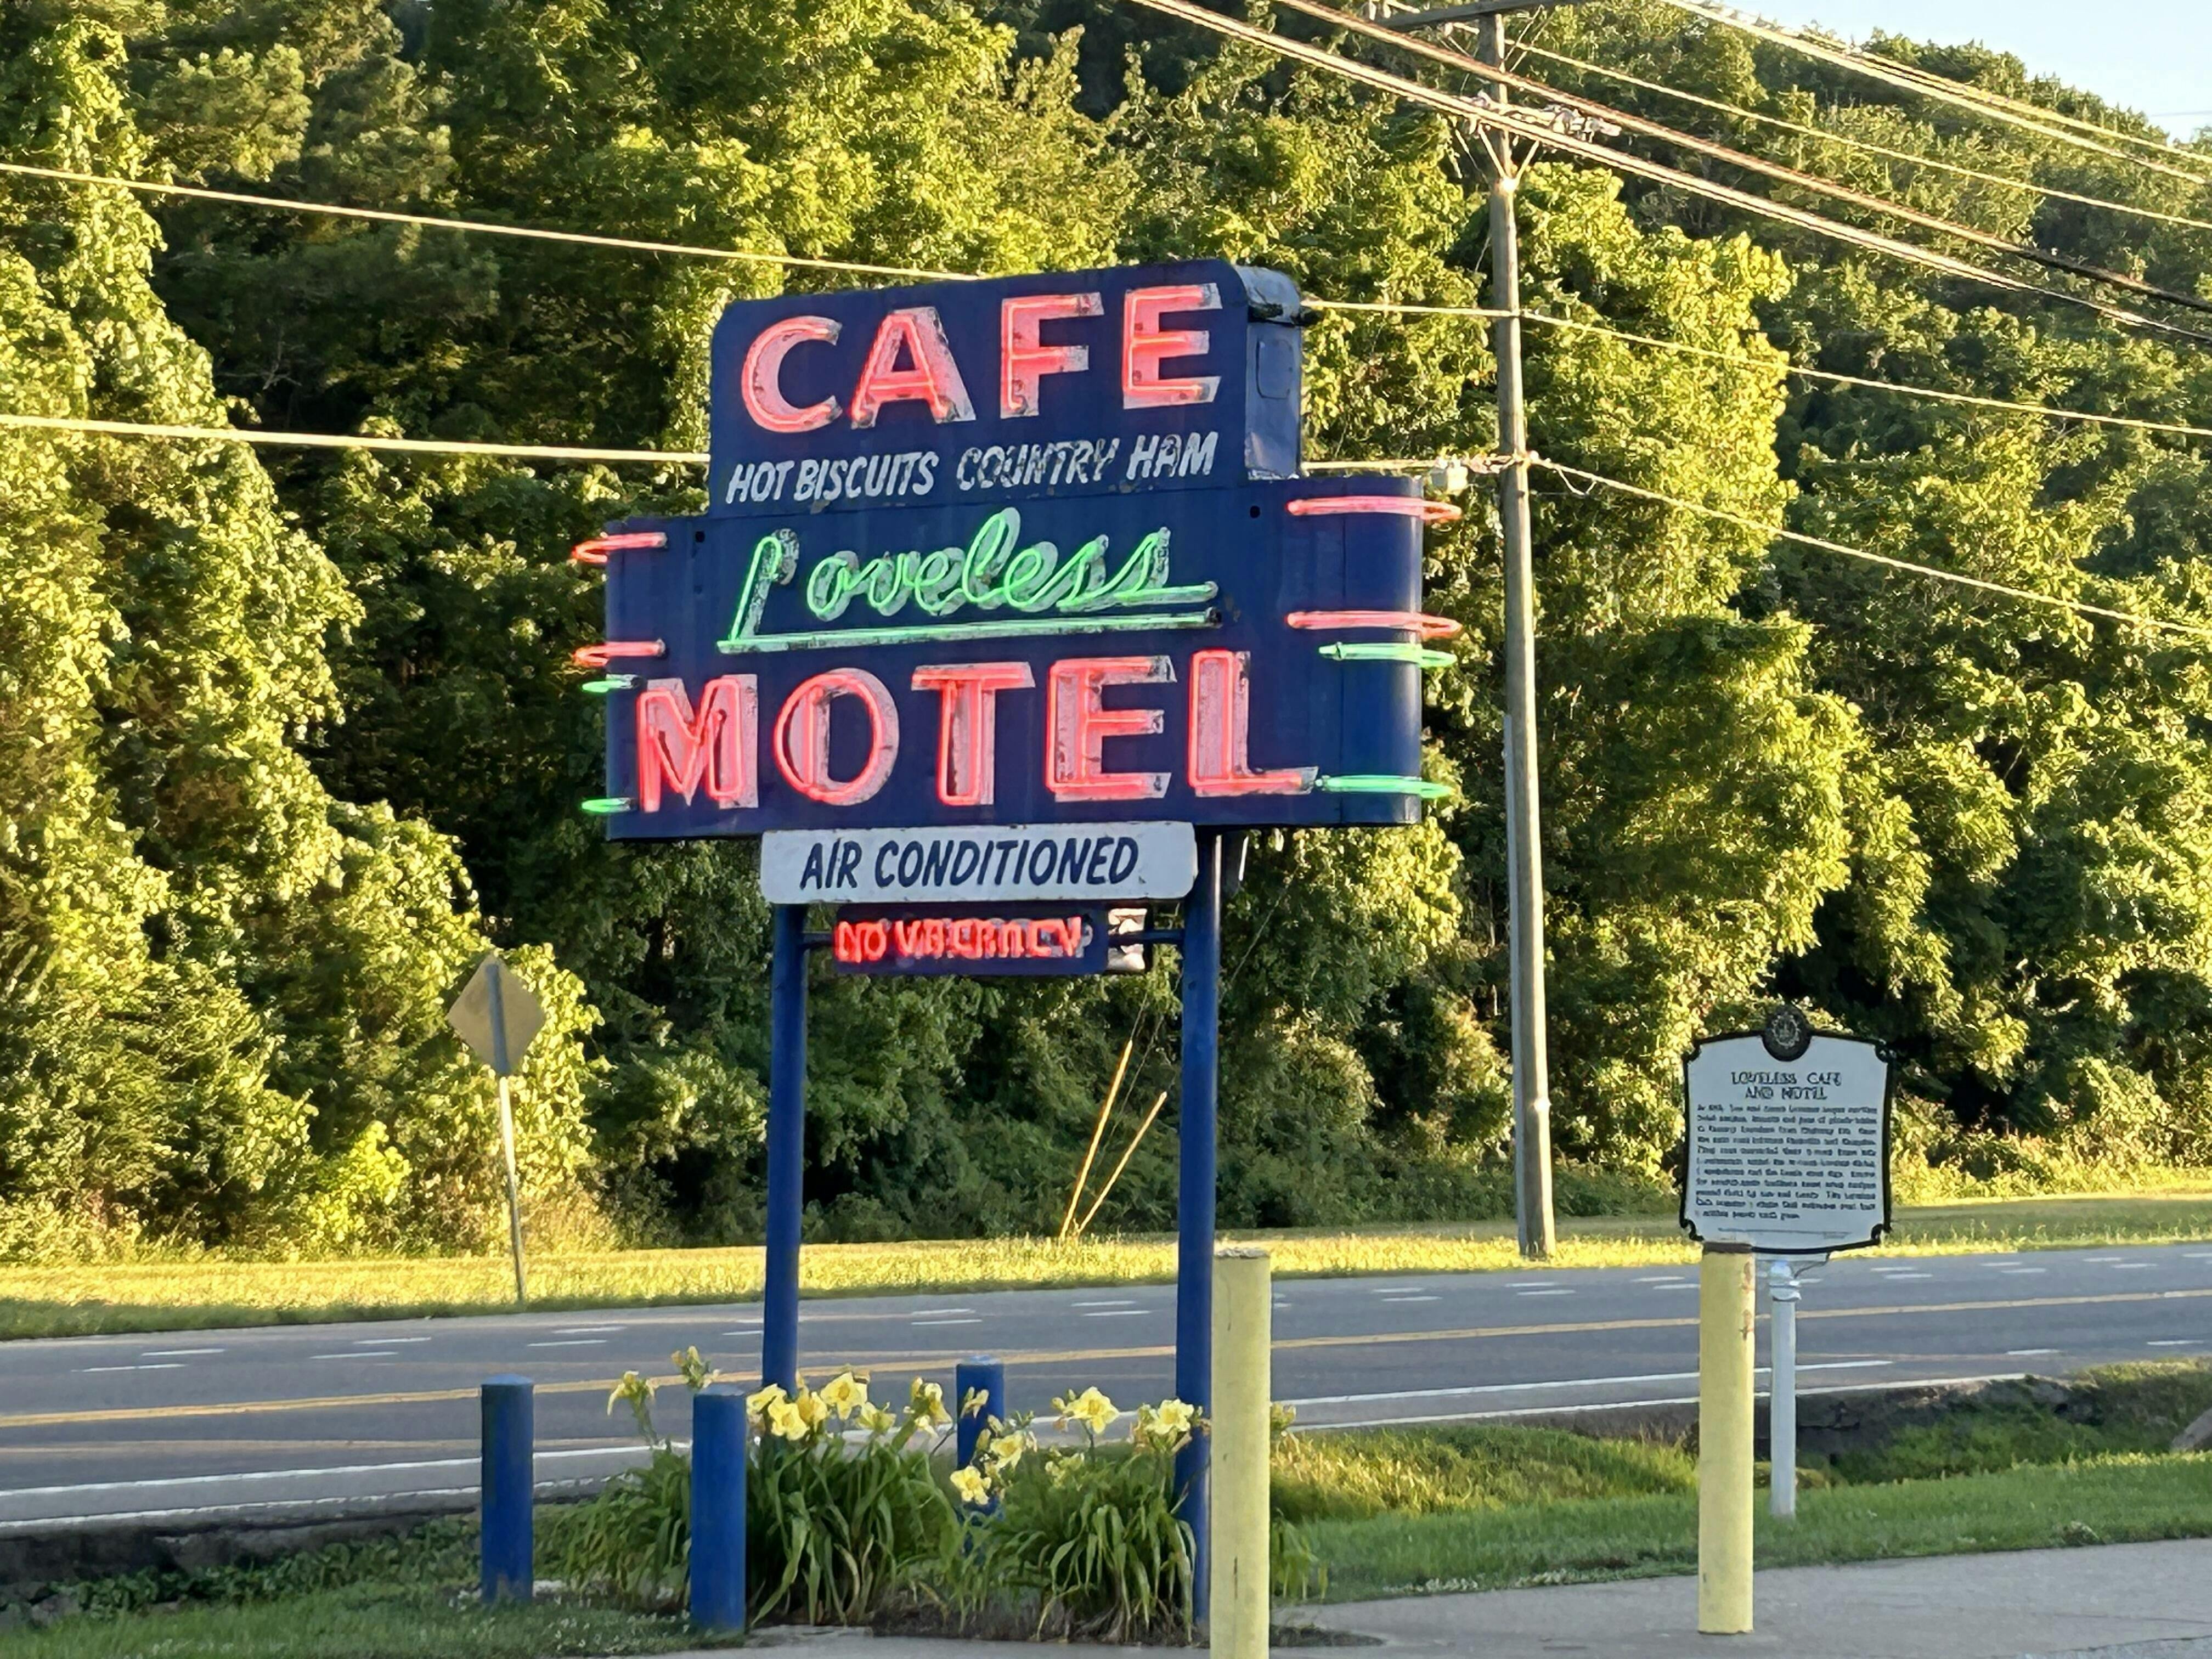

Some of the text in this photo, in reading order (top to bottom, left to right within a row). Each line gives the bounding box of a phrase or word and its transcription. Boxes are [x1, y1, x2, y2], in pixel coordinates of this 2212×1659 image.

[741, 283, 1222, 432] CAFE
[726, 431, 1218, 503] HOT BISCUITS COUNTRY HAM
[715, 507, 1220, 653] Loveless
[637, 650, 1318, 812] MOTEL
[800, 837, 1139, 889] AIR CONDITIONED
[834, 918, 890, 962] NO
